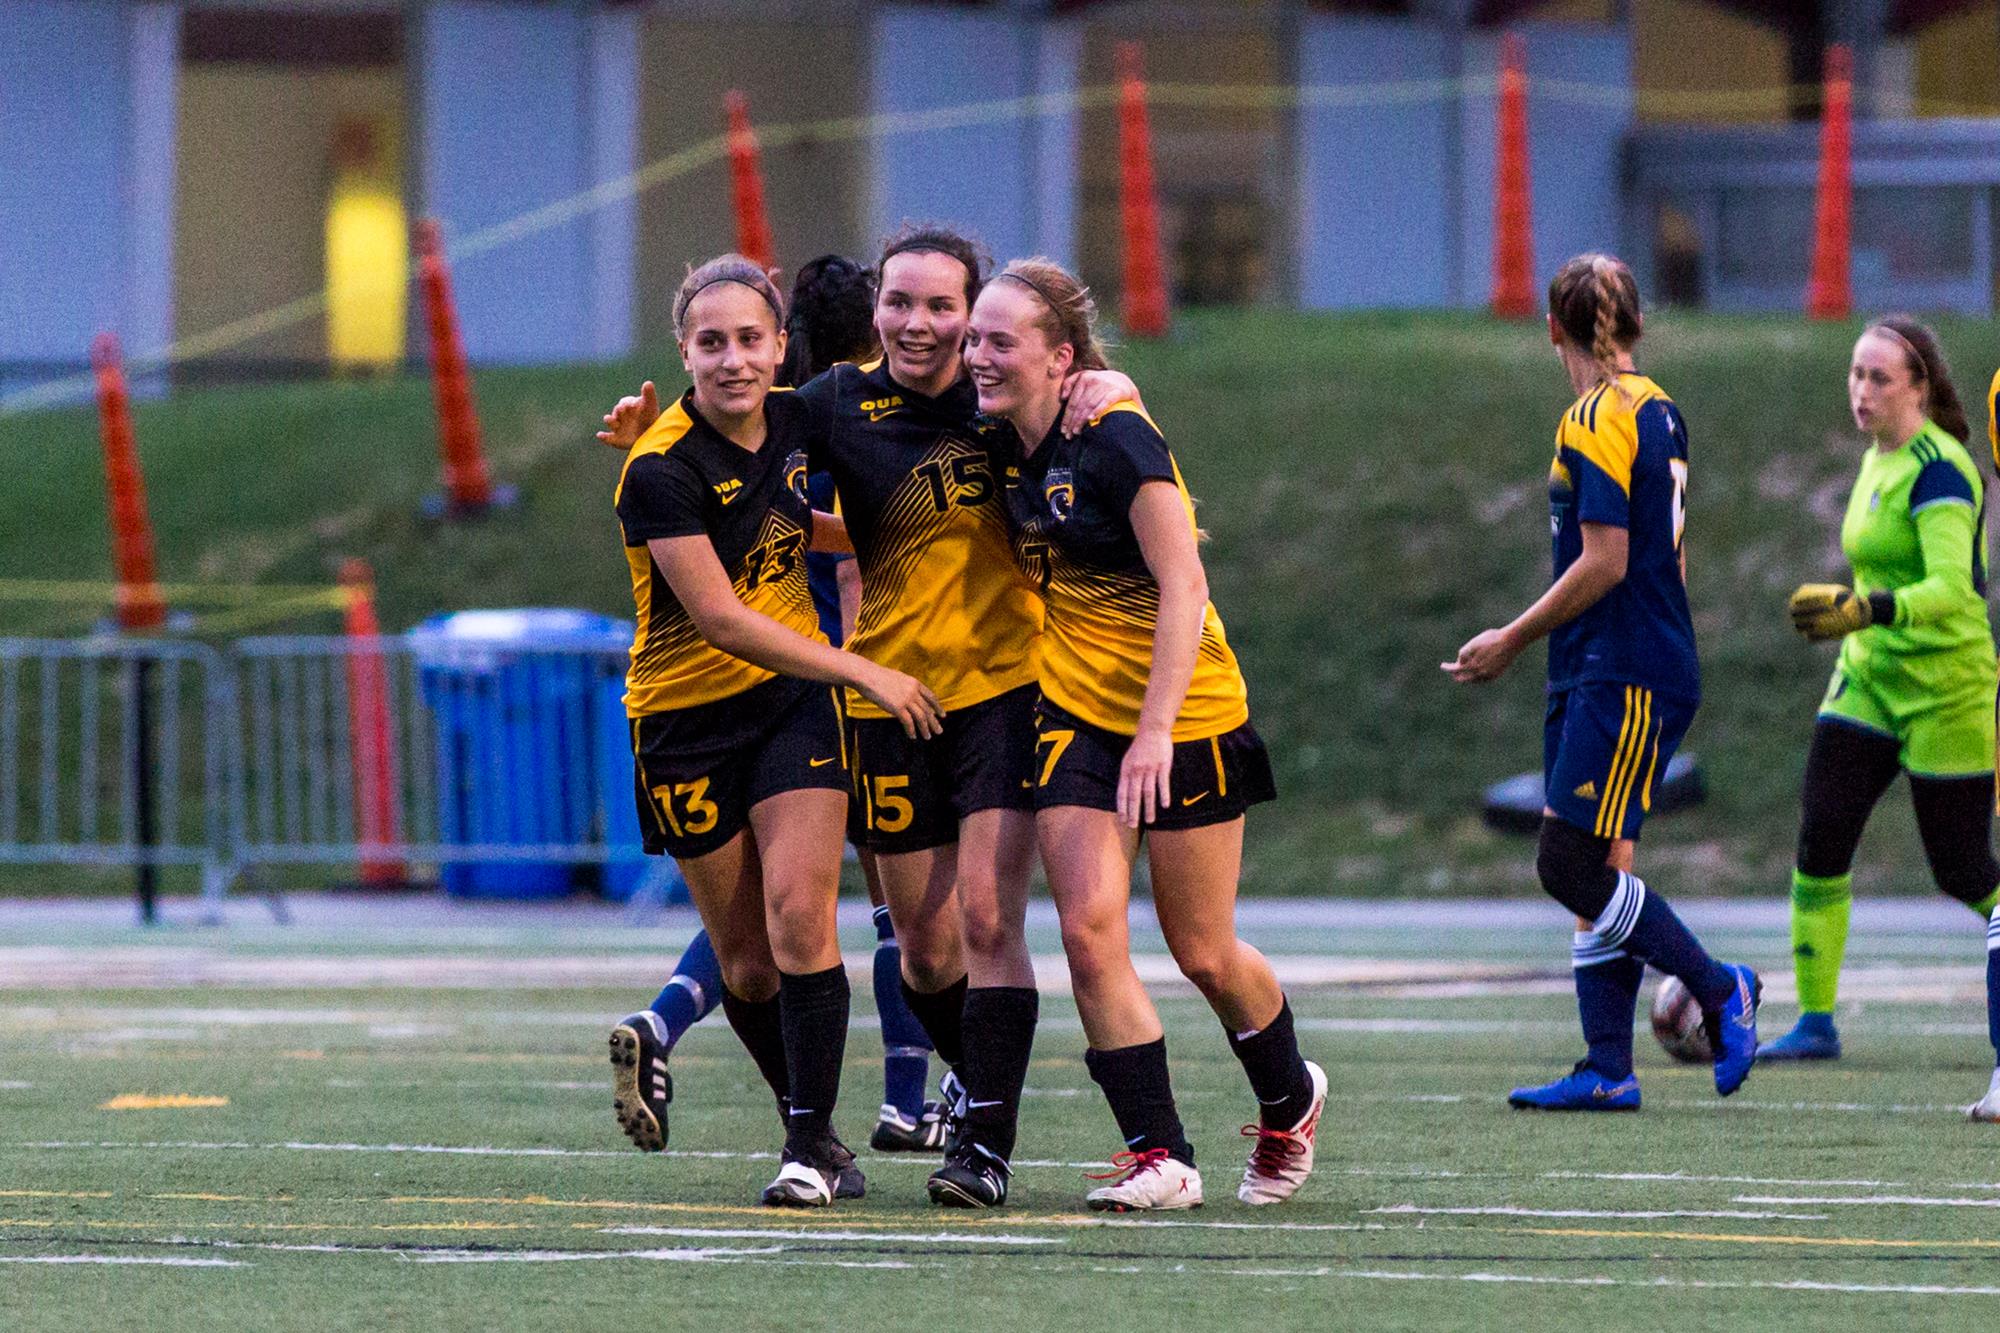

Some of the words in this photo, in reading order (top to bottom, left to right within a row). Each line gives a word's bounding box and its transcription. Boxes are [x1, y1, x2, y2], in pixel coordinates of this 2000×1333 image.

[912, 451, 996, 513] 15
[745, 529, 803, 591] 13
[1040, 730, 1076, 787] 7
[652, 776, 719, 838] 13
[863, 774, 914, 833] 15
